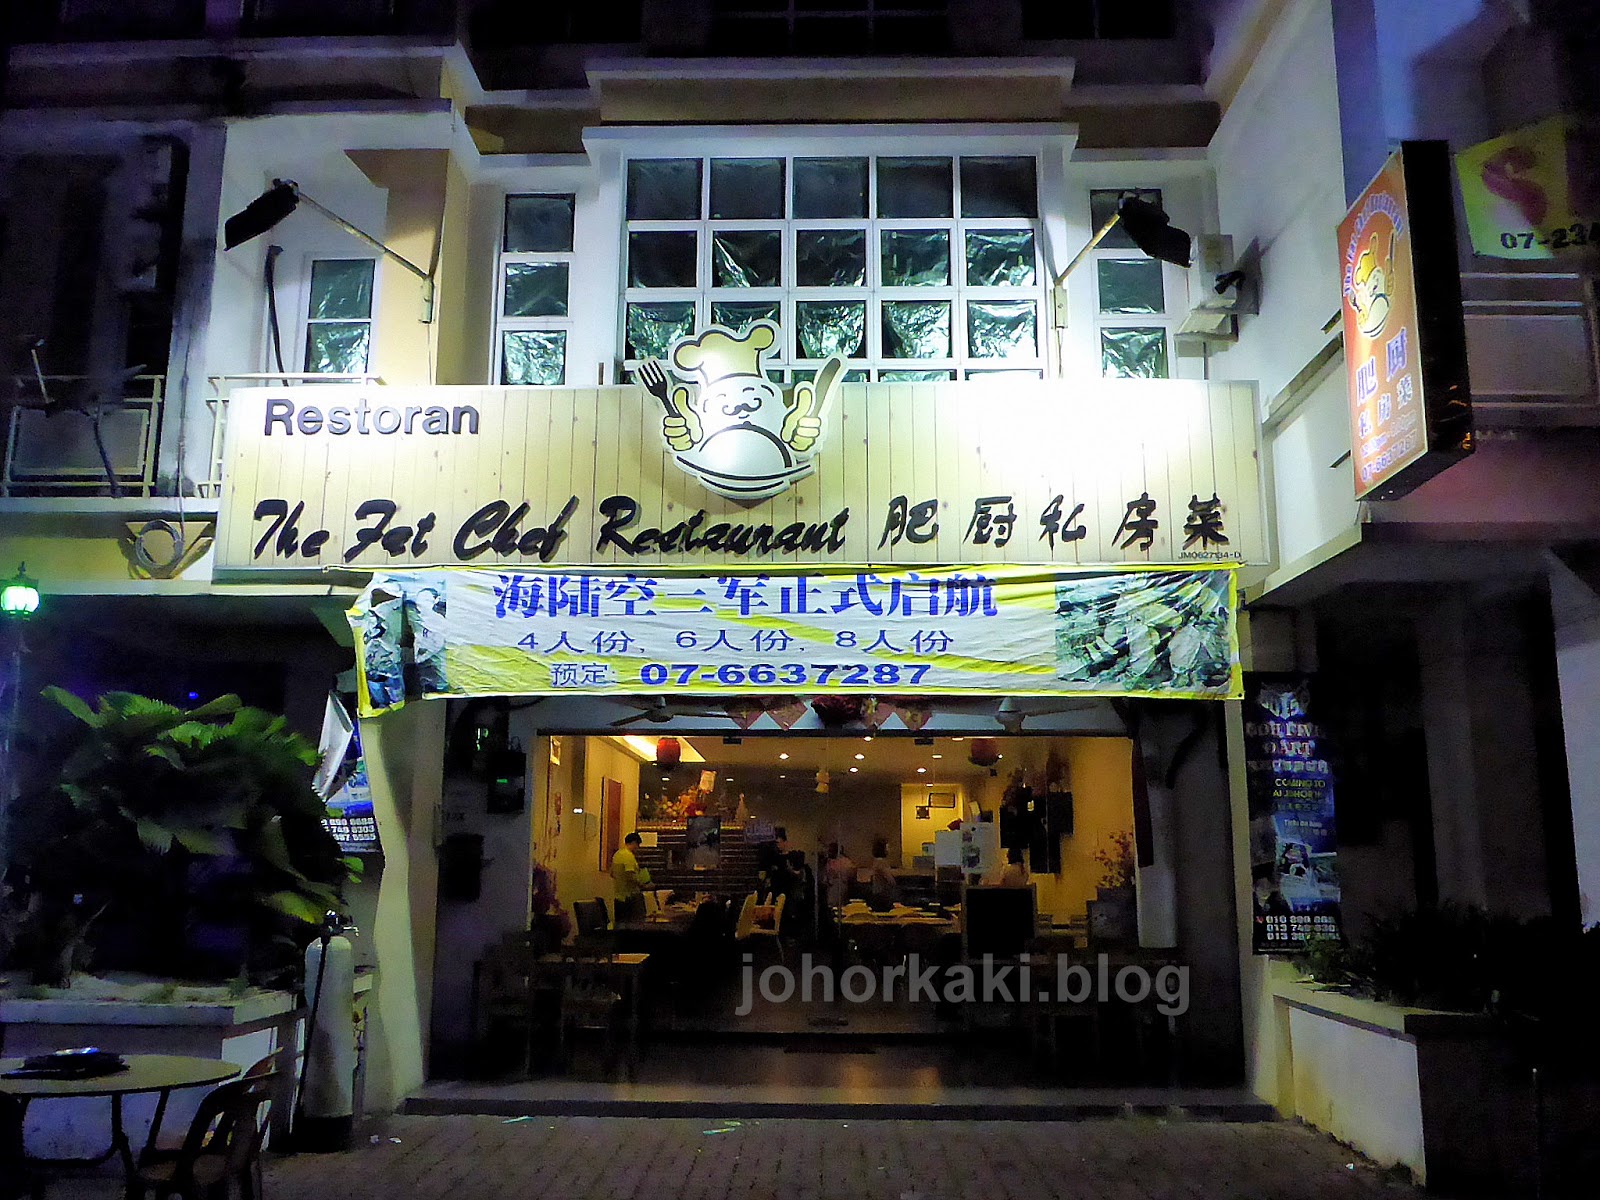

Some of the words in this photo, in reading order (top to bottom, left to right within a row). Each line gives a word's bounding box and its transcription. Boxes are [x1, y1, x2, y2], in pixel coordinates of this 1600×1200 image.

[264, 398, 480, 436] Restoran
[254, 500, 330, 560] The
[453, 495, 580, 562] Chef
[596, 495, 850, 557] Restaurant
[877, 492, 1230, 551] 肥厨私房菜
[640, 663, 932, 685] 07-6637287
